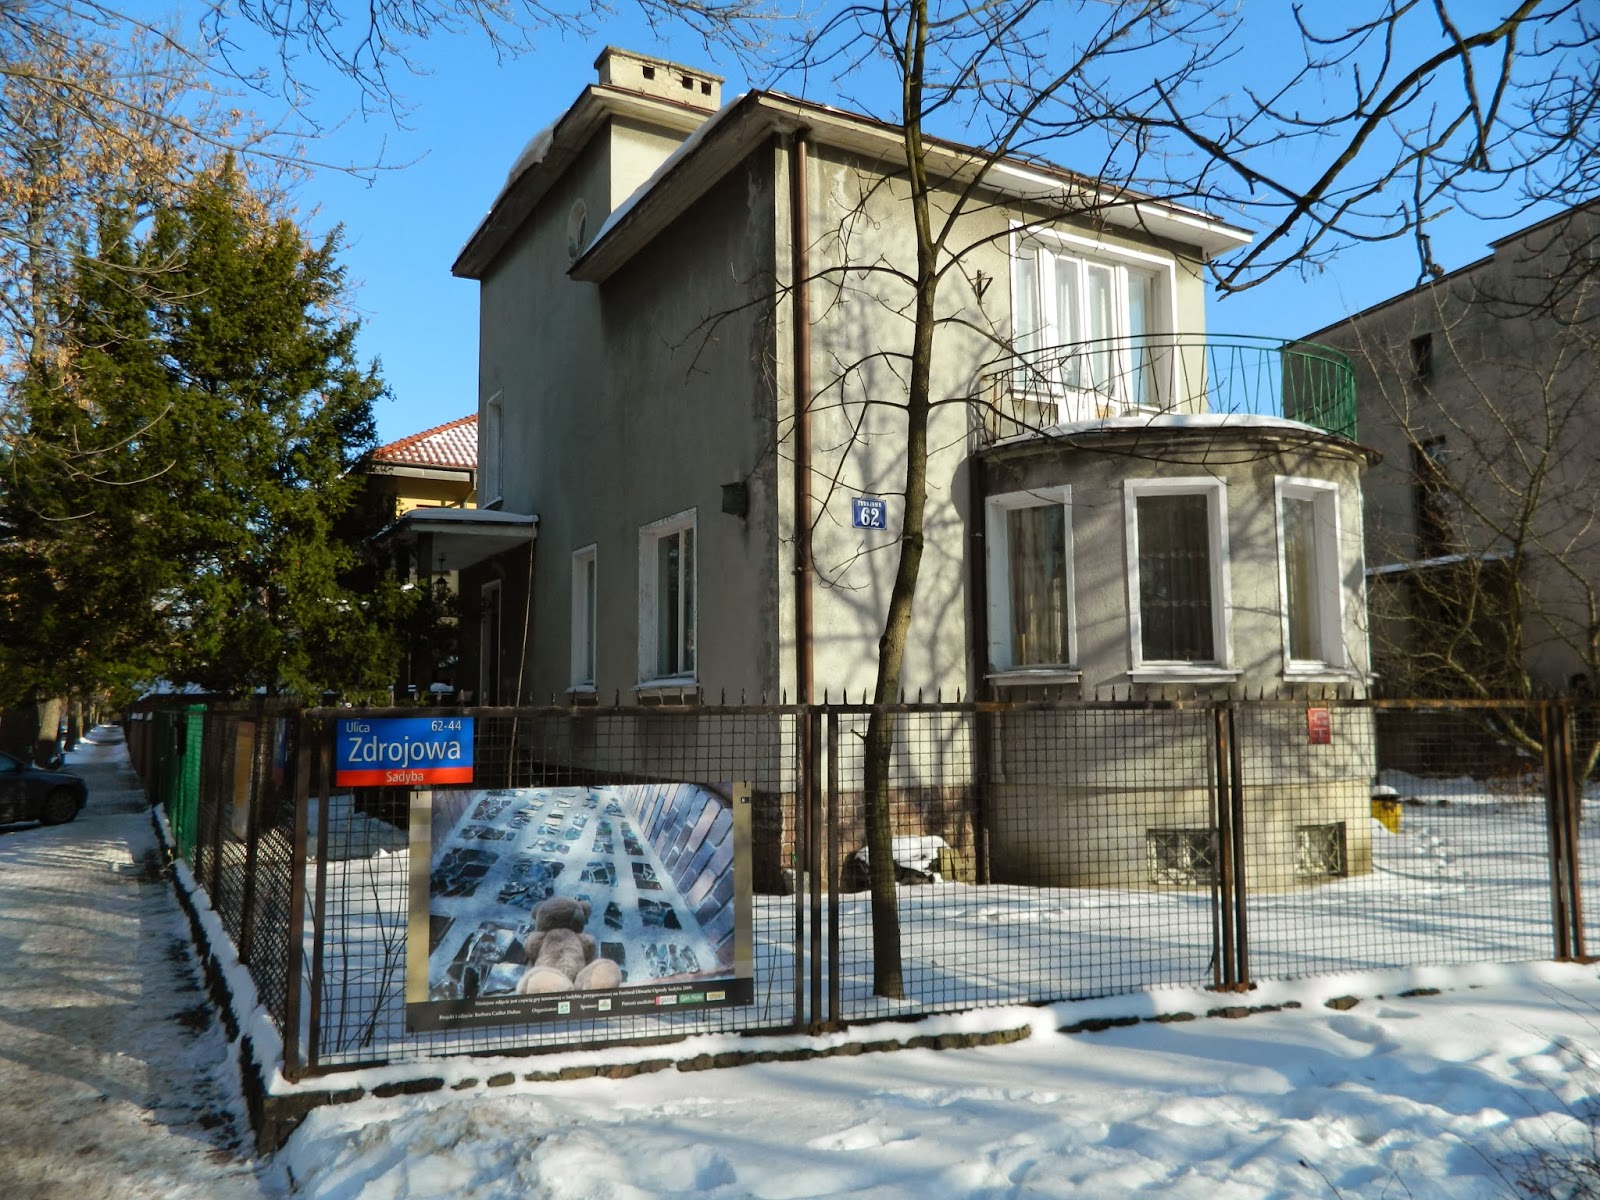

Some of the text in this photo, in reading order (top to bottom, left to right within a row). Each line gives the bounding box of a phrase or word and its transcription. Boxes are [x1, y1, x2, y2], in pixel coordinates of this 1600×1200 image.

[860, 507, 880, 527] 62
[346, 720, 461, 733] Ulica 62-44
[348, 735, 461, 768] Zdrojowa
[386, 770, 424, 784] Sadyba
